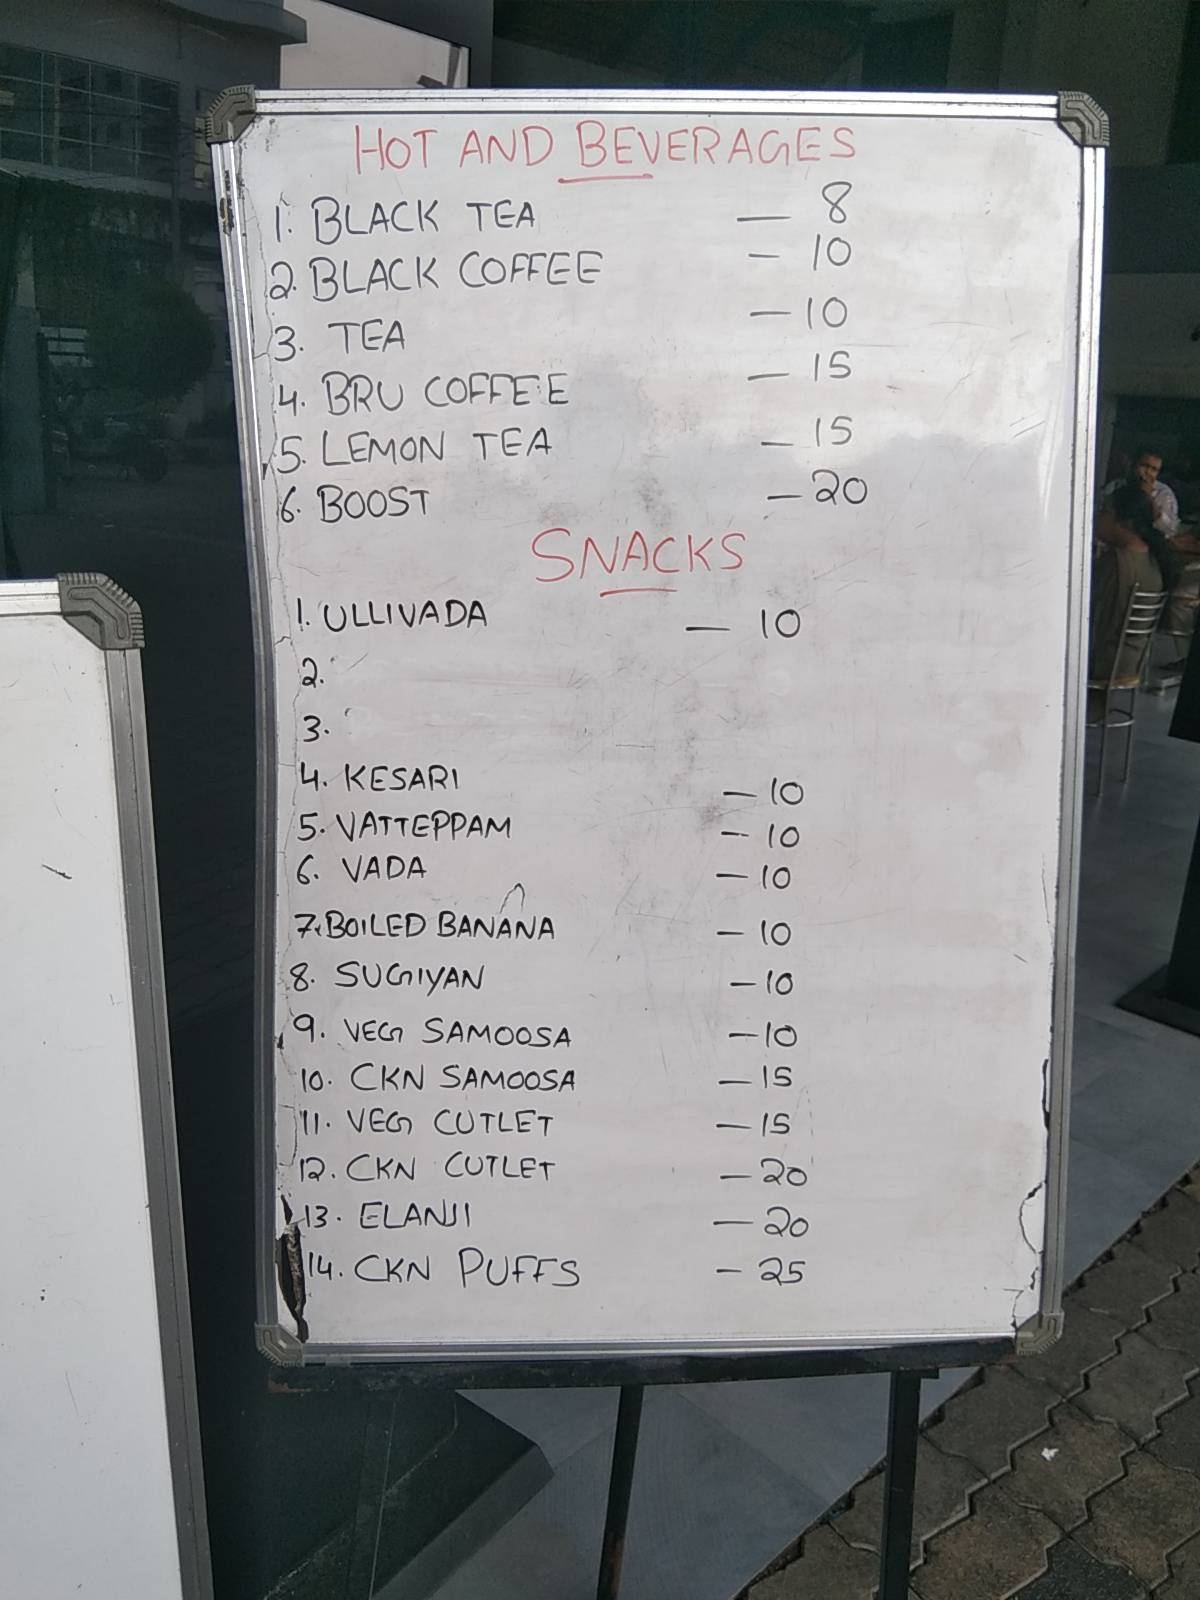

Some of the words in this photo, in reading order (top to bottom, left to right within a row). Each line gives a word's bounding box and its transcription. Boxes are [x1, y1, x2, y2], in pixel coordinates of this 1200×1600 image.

[355, 125, 437, 174] HOT
[460, 126, 553, 168] AND
[576, 117, 860, 167] BEVERAGES
[276, 200, 292, 242] 1.
[311, 196, 438, 245] BLACK
[466, 199, 535, 231] TEA
[822, 181, 852, 224] 8
[267, 261, 296, 300] 2.
[309, 256, 439, 302] BLACK
[459, 251, 603, 288] COFFEE
[813, 234, 851, 271] 10
[272, 325, 304, 361] 3.
[328, 319, 405, 354] TEA
[808, 297, 847, 329] 10
[279, 384, 305, 416] 4.
[322, 371, 403, 416] BRU
[425, 372, 568, 407] COFFEE
[815, 351, 851, 381] 15
[275, 435, 306, 476] 5.
[323, 430, 444, 466] LEMON
[472, 427, 552, 460] TEA
[816, 416, 852, 447] 15
[278, 484, 301, 523] 6.
[317, 484, 429, 523] BOOST
[812, 469, 867, 505] 20
[532, 528, 745, 582] SNACKS
[297, 598, 310, 628] 1.
[321, 599, 487, 632] ULLIVADA
[762, 609, 800, 639] 10
[302, 657, 324, 688] 2.
[303, 715, 329, 742] 3.
[301, 762, 327, 791] 4.
[345, 763, 458, 791] KESARI
[771, 777, 804, 805] 10
[297, 812, 325, 841] 5.
[336, 810, 510, 842] VATTEPPAM
[769, 824, 800, 848] 10
[297, 854, 319, 885] 6.
[342, 855, 427, 883] VADA
[763, 865, 790, 889] 10
[325, 910, 426, 939] BOILED
[437, 909, 554, 940] BANANA
[761, 920, 791, 946] 10
[288, 962, 315, 992] 8.
[335, 961, 484, 996] SUGIYAN
[767, 970, 793, 995] 10
[292, 1012, 325, 1043] 9.
[344, 1019, 403, 1043] VEG
[422, 1017, 571, 1048] SAMOOSA
[766, 1022, 797, 1048] 10
[302, 1068, 332, 1092] 10.
[351, 1063, 423, 1091] CKN
[440, 1064, 575, 1092] SAMOOSA
[763, 1065, 792, 1088] 15
[301, 1110, 330, 1135] 11.
[347, 1108, 412, 1135] VEG
[434, 1109, 553, 1136] CUTLET
[763, 1113, 790, 1136] 15
[300, 1157, 335, 1182] 12.
[346, 1154, 415, 1181] CKN
[445, 1151, 555, 1180] CUTLET
[761, 1158, 810, 1186] 20
[303, 1205, 341, 1228] 13.
[360, 1199, 470, 1229] ELANJI
[764, 1206, 809, 1237] 20
[309, 1252, 343, 1280] 14.
[354, 1255, 429, 1283] CKN
[458, 1247, 579, 1288] PUFFS
[759, 1257, 805, 1286] 25
